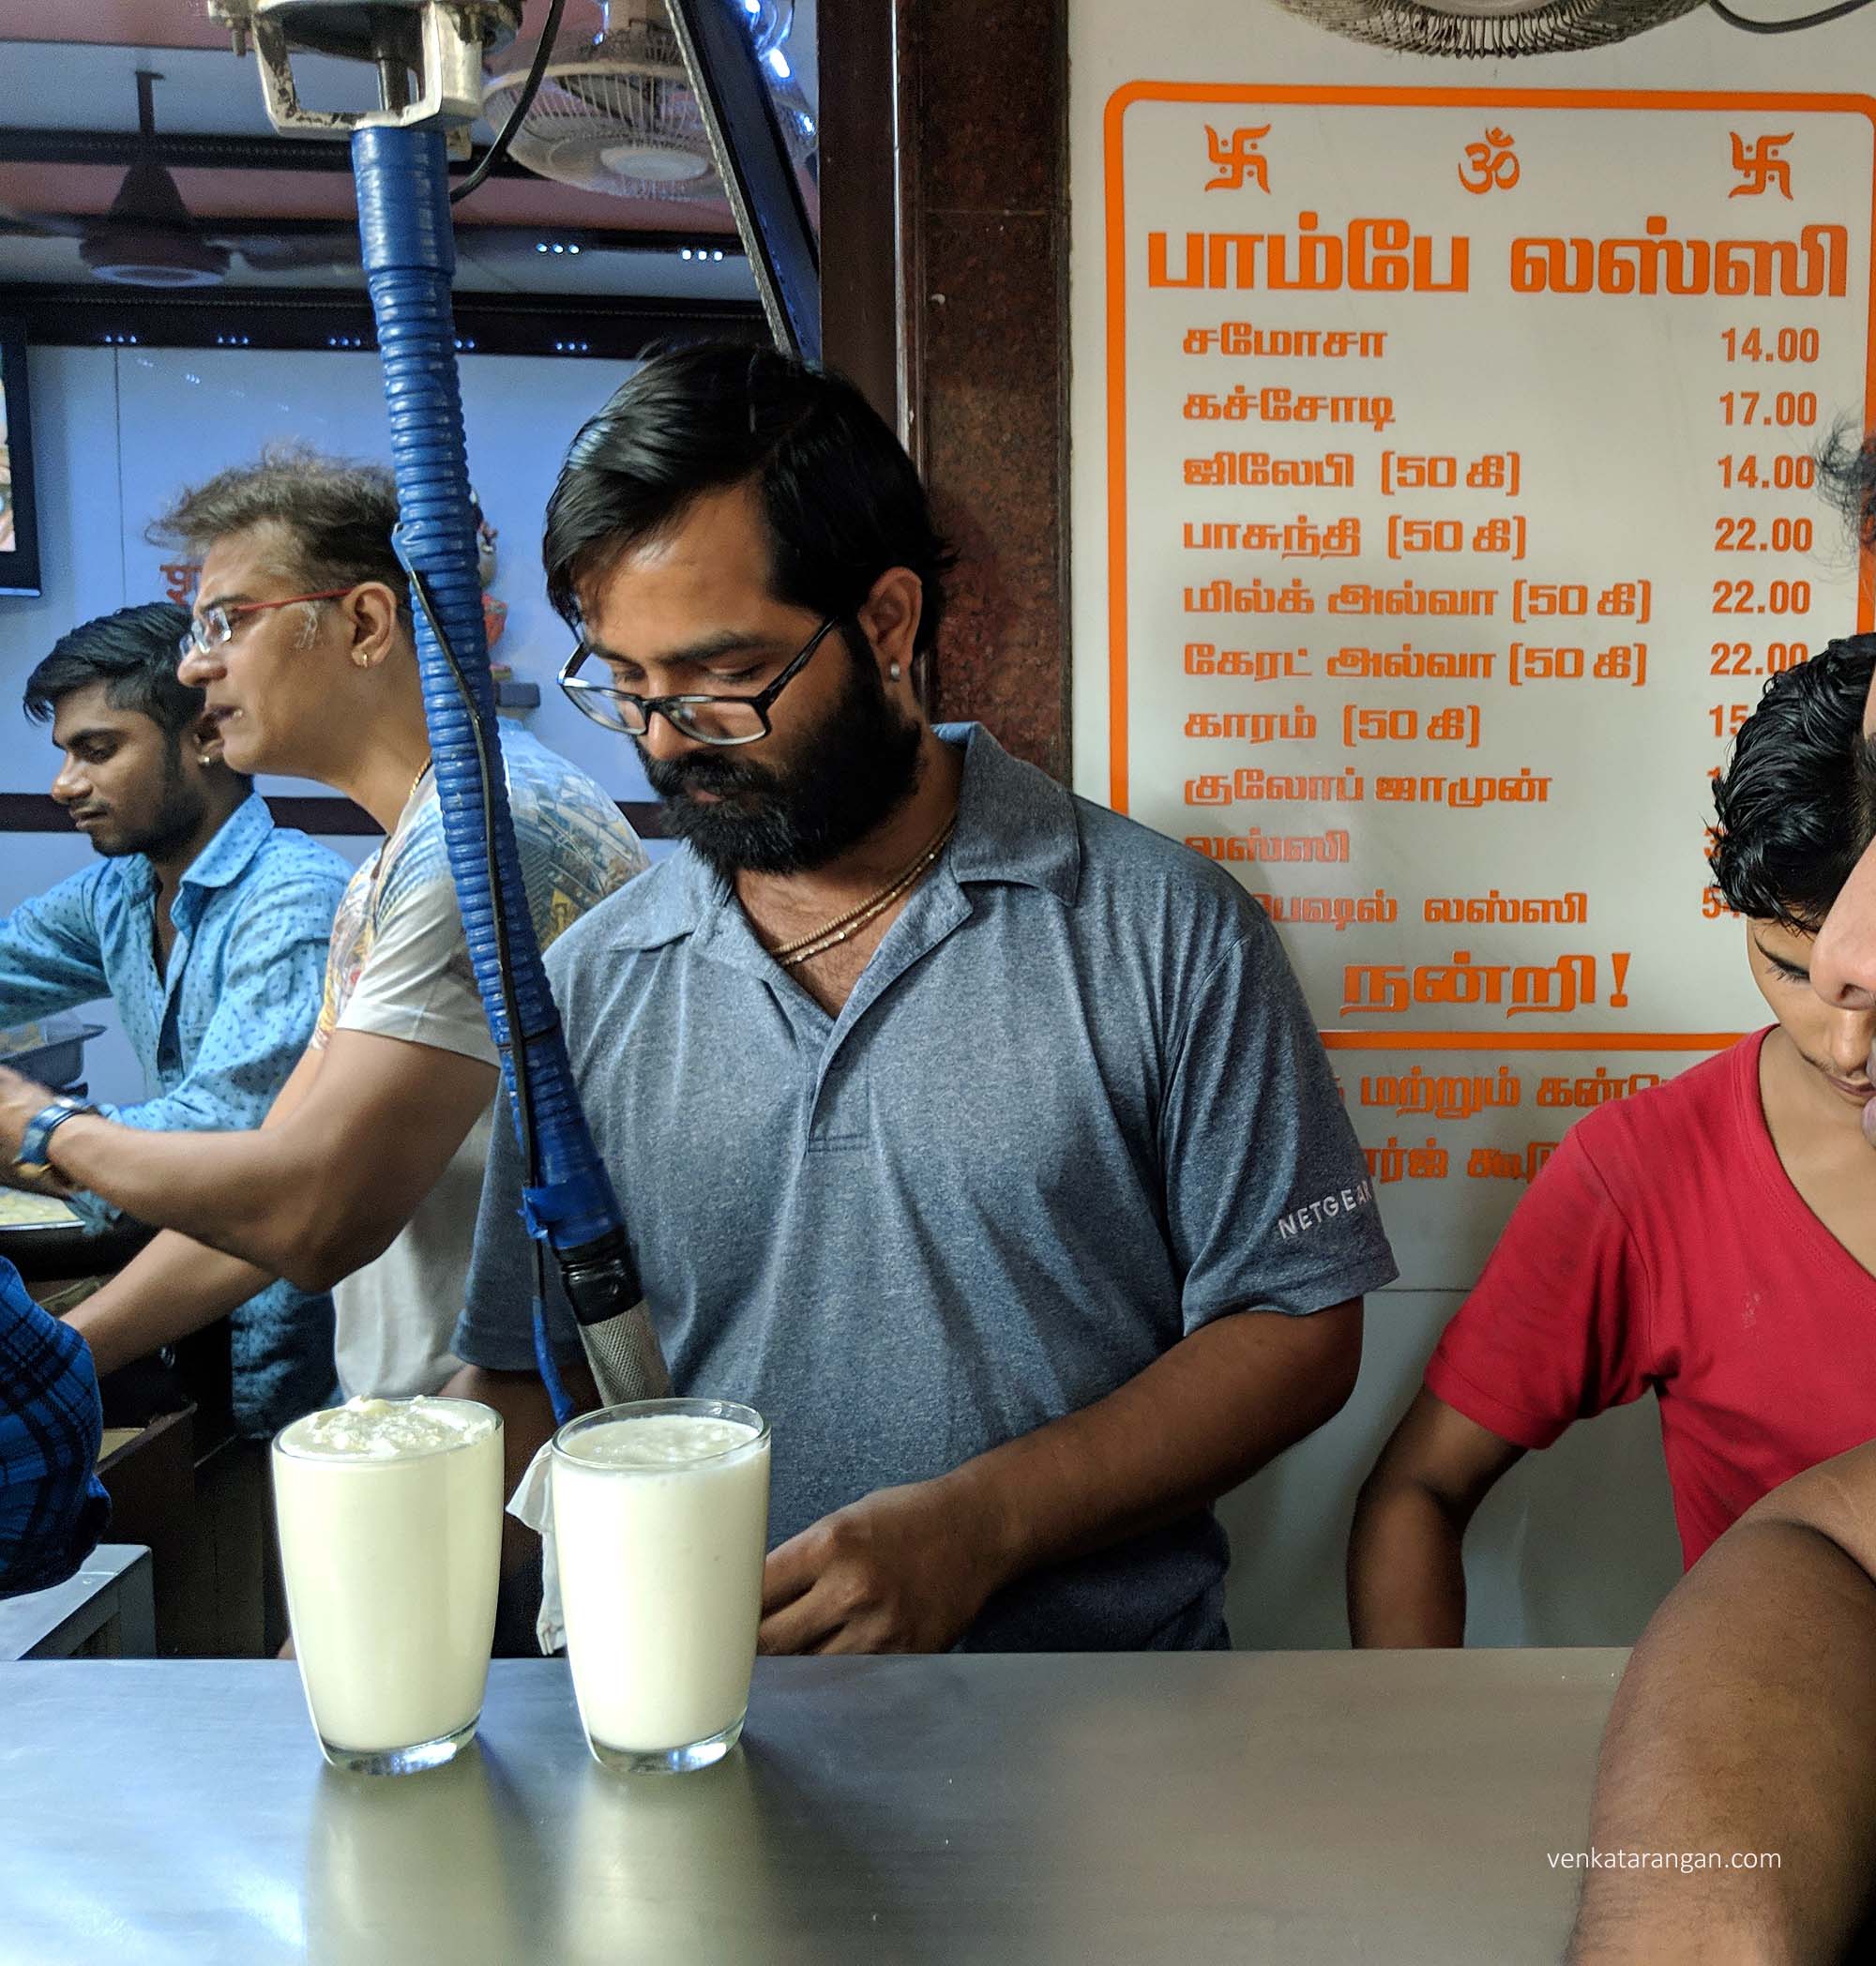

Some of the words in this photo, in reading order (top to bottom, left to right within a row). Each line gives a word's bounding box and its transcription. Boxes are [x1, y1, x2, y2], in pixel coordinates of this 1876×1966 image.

[1147, 210, 1470, 293] பாம்பே
[1510, 215, 1849, 297] லஸ்ஸி
[1183, 322, 1387, 358] சமோசா
[1720, 327, 1820, 363] 14.00
[1183, 385, 1396, 431] கச்சோடி
[1719, 391, 1817, 427] 17.00
[1184, 451, 1354, 488] ஜிலேபி
[1717, 455, 1815, 490] 14.00
[1184, 515, 1360, 560] பாசுந்தி
[1715, 518, 1813, 552] 22.00
[1184, 578, 1314, 615] மில்க்
[1327, 580, 1498, 616] அல்வா
[1712, 581, 1811, 615] 22.00
[1184, 643, 1312, 682] கேரட்
[1326, 643, 1496, 679] அல்வா
[1184, 704, 1317, 744] காரம்
[1184, 766, 1365, 807] குலோப்
[1376, 767, 1552, 809] ஜாமுன்
[1185, 826, 1349, 863] லஸ்ஸி
[1424, 889, 1588, 925] லஸ்ஸி
[1360, 1065, 1522, 1121] மற்றும்
